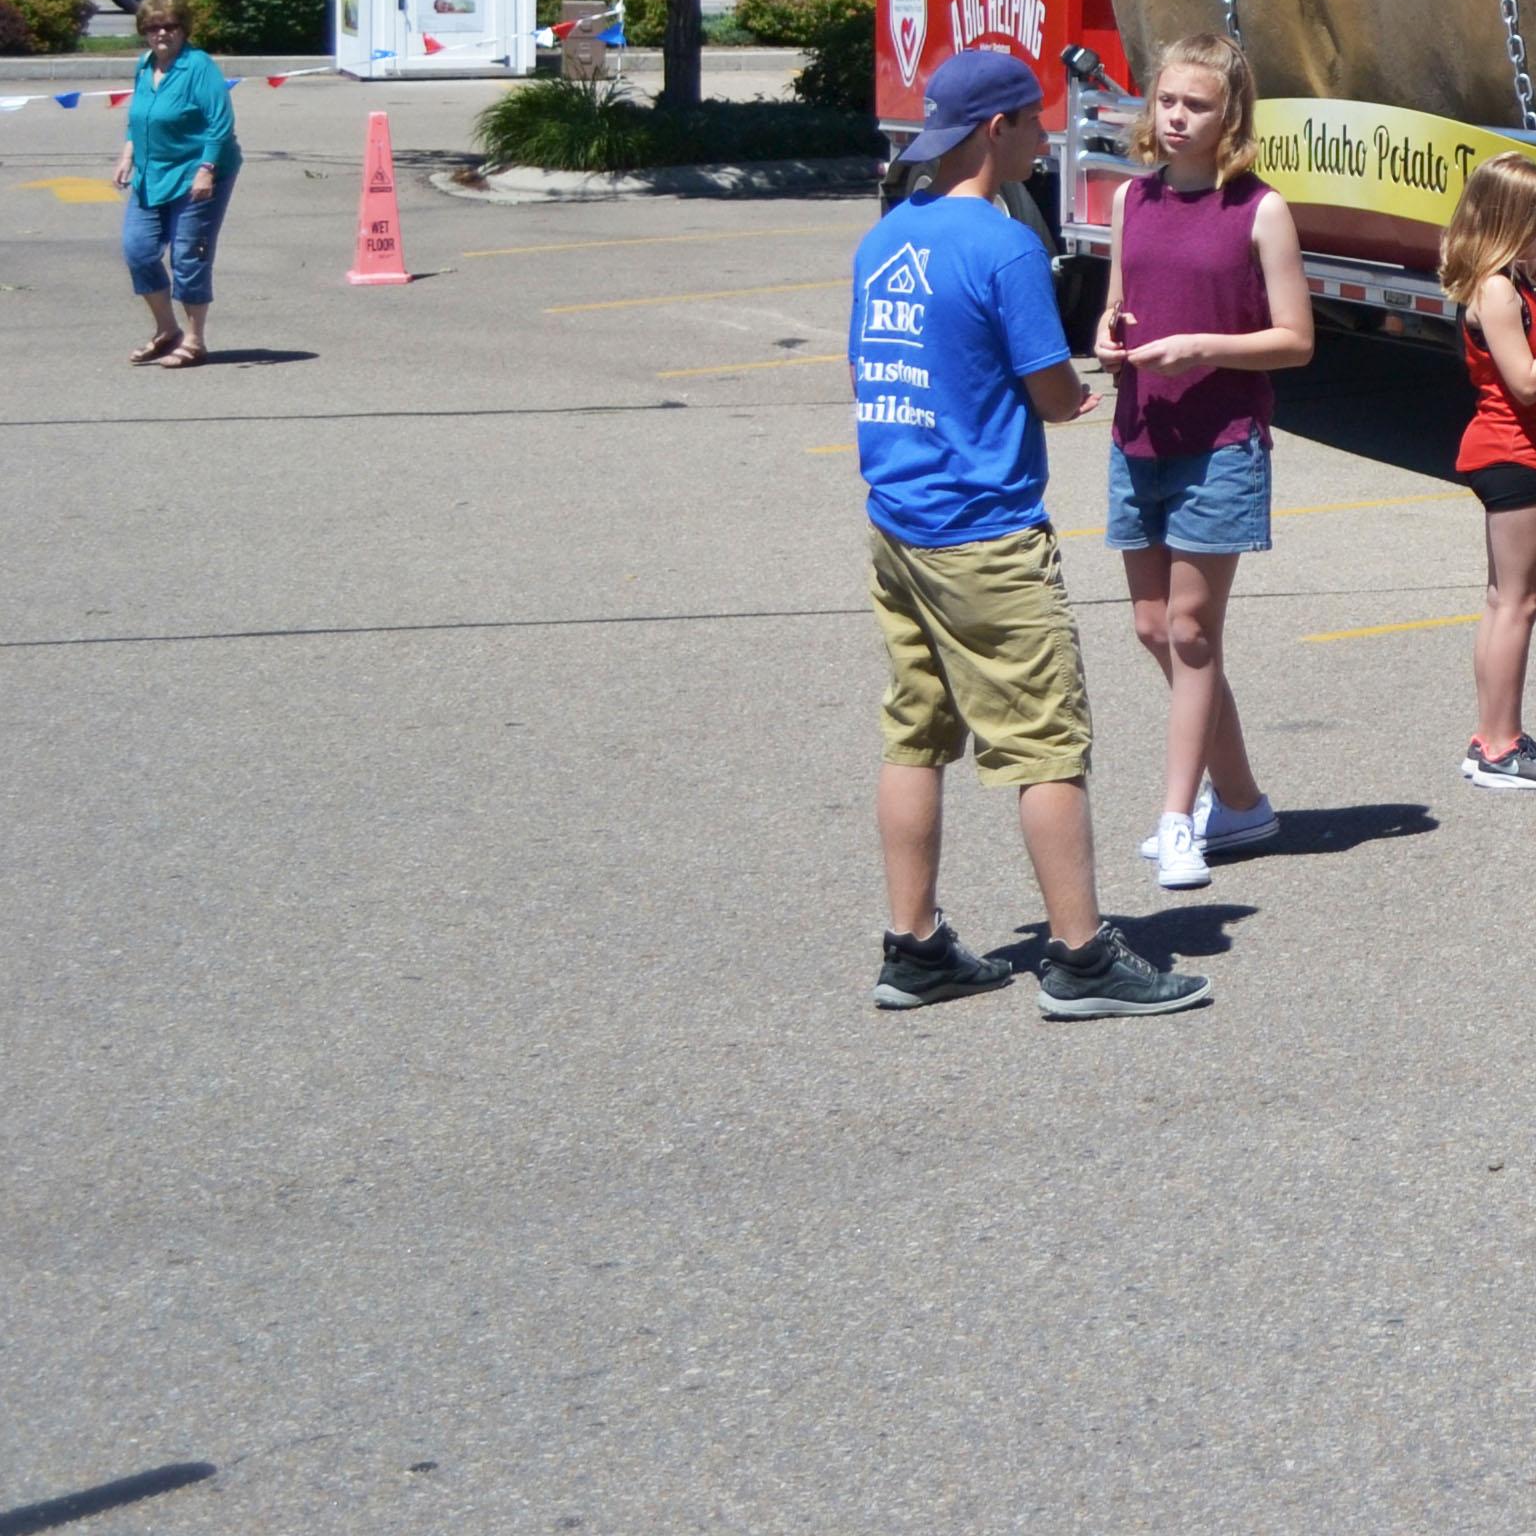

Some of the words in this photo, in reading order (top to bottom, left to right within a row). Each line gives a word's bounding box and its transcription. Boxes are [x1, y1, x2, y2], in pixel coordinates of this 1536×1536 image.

[1303, 117, 1368, 179] Idaho
[1373, 124, 1449, 194] Potato
[371, 220, 390, 234] WET
[367, 237, 395, 252] FLOOR
[868, 299, 925, 335] RBC
[856, 395, 936, 429] uilders
